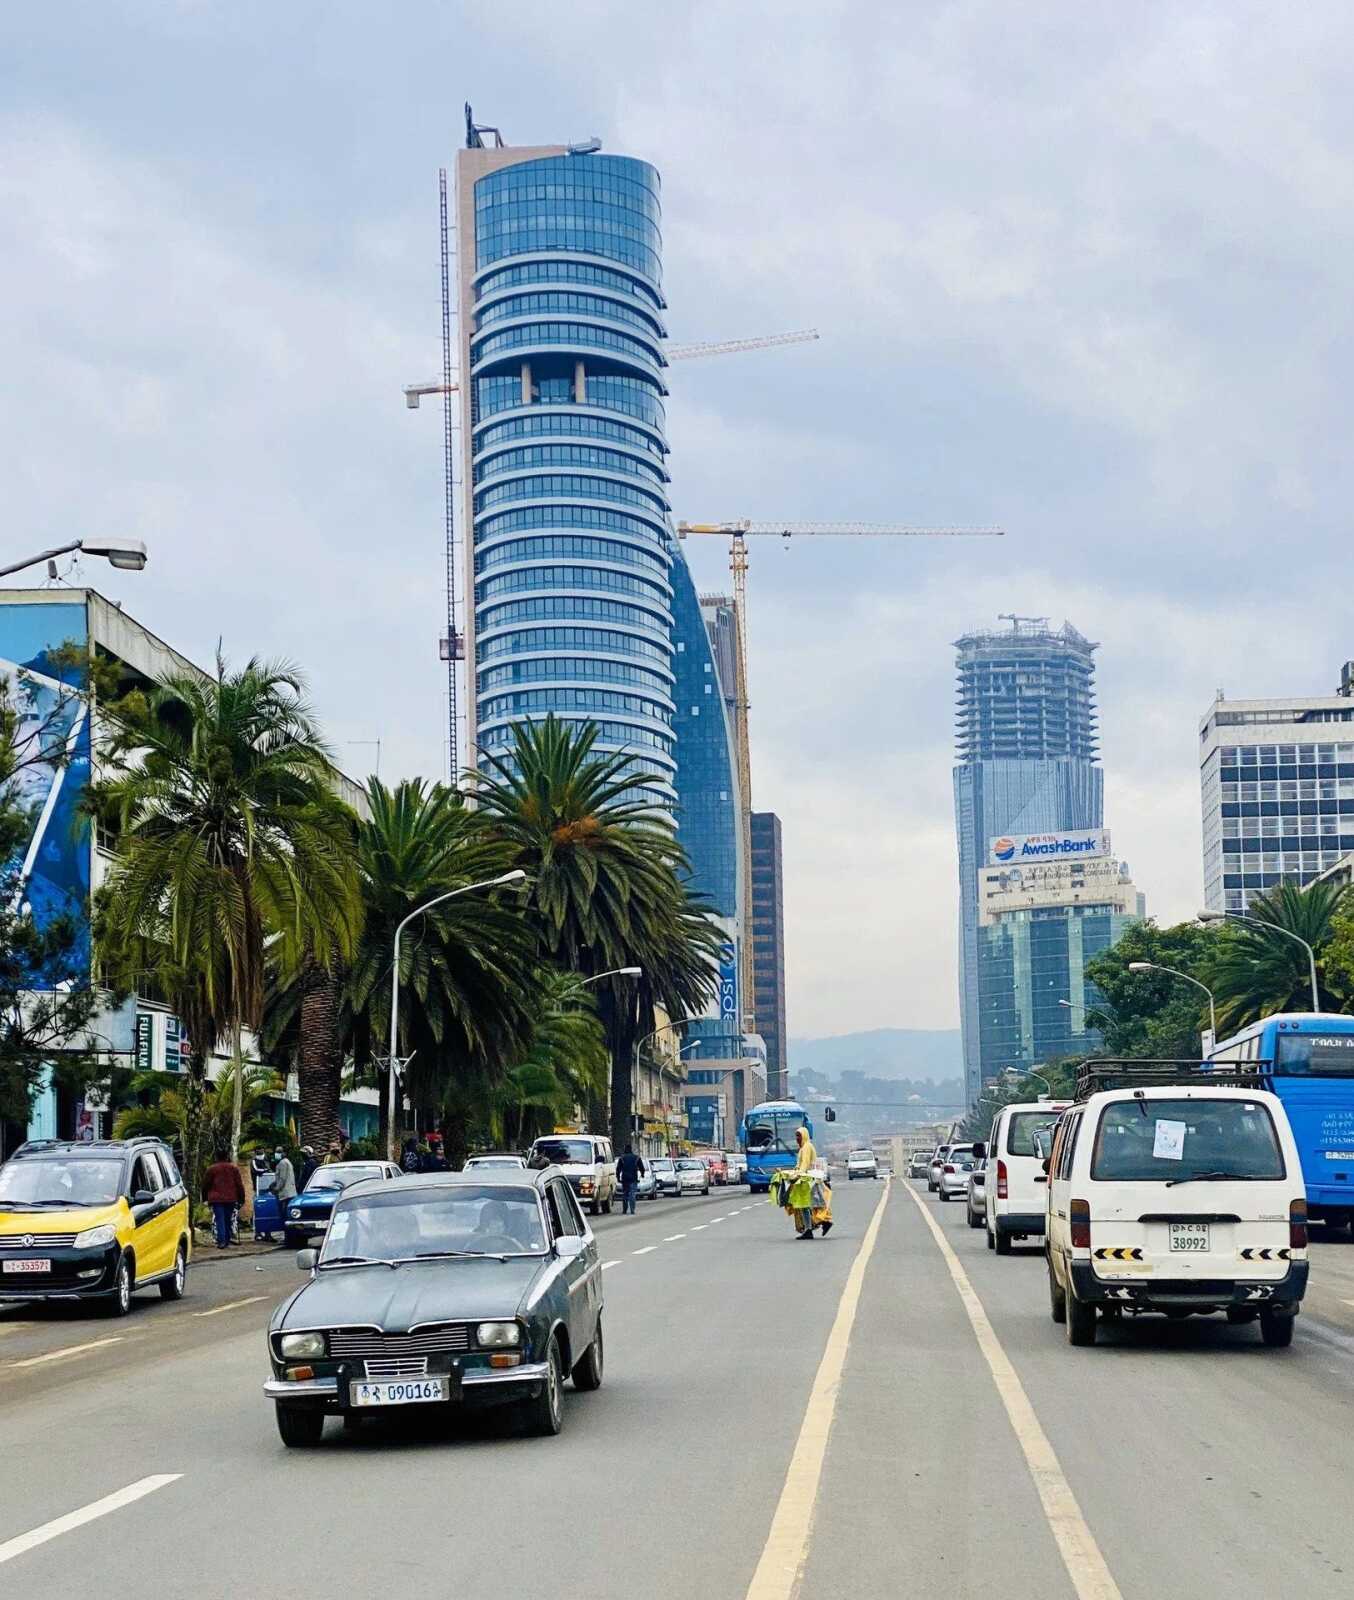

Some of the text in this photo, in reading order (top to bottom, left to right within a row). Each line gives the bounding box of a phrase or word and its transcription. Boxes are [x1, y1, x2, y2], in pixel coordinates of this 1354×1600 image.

[1022, 838, 1096, 855] AwashBank
[723, 978, 736, 1020] epsi
[1173, 1237, 1206, 1249] 38992
[388, 1383, 431, 1400] 09016
